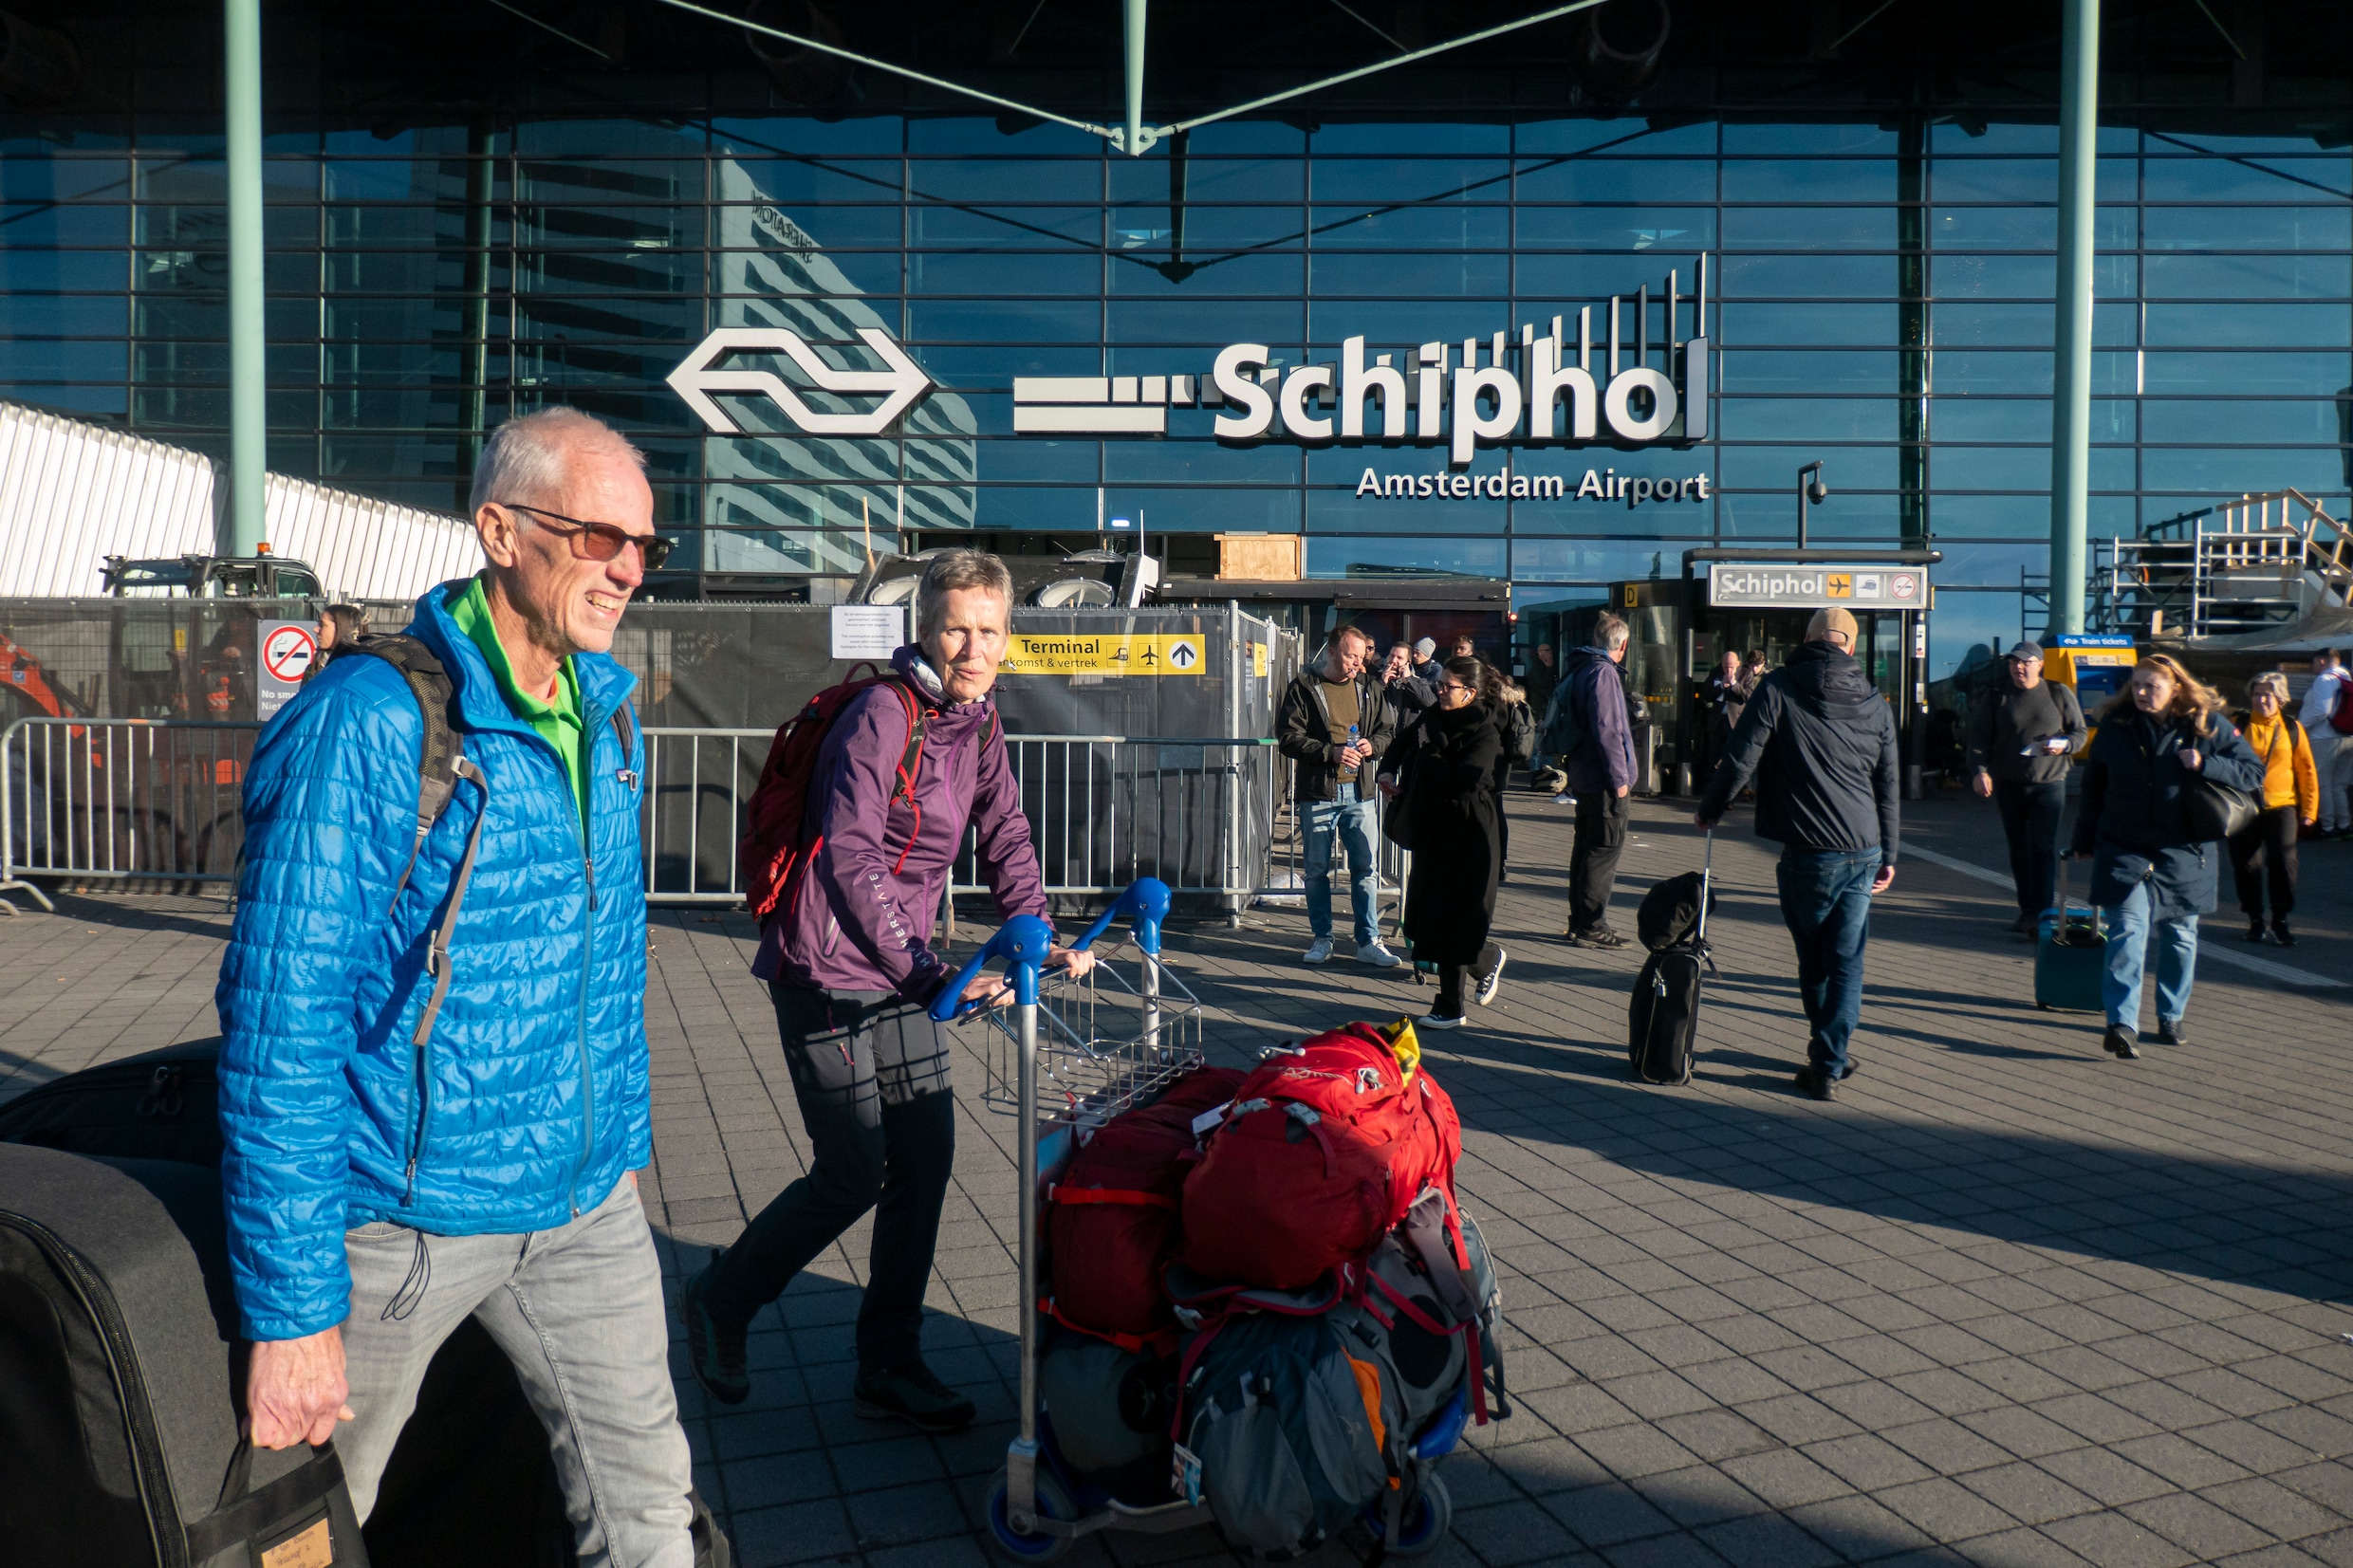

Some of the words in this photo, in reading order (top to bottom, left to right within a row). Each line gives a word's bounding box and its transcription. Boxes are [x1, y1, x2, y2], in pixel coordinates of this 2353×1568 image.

[1213, 335, 1708, 464] Schiphol
[1356, 468, 1564, 498] Amsterdam
[1578, 469, 1710, 507] Airport
[1720, 572, 1823, 599] Schiphol
[1627, 587, 1635, 603] D
[1021, 639, 1100, 654] Terminal
[1047, 657, 1055, 668] &
[1058, 657, 1098, 668] vertrek
[261, 690, 275, 698] No
